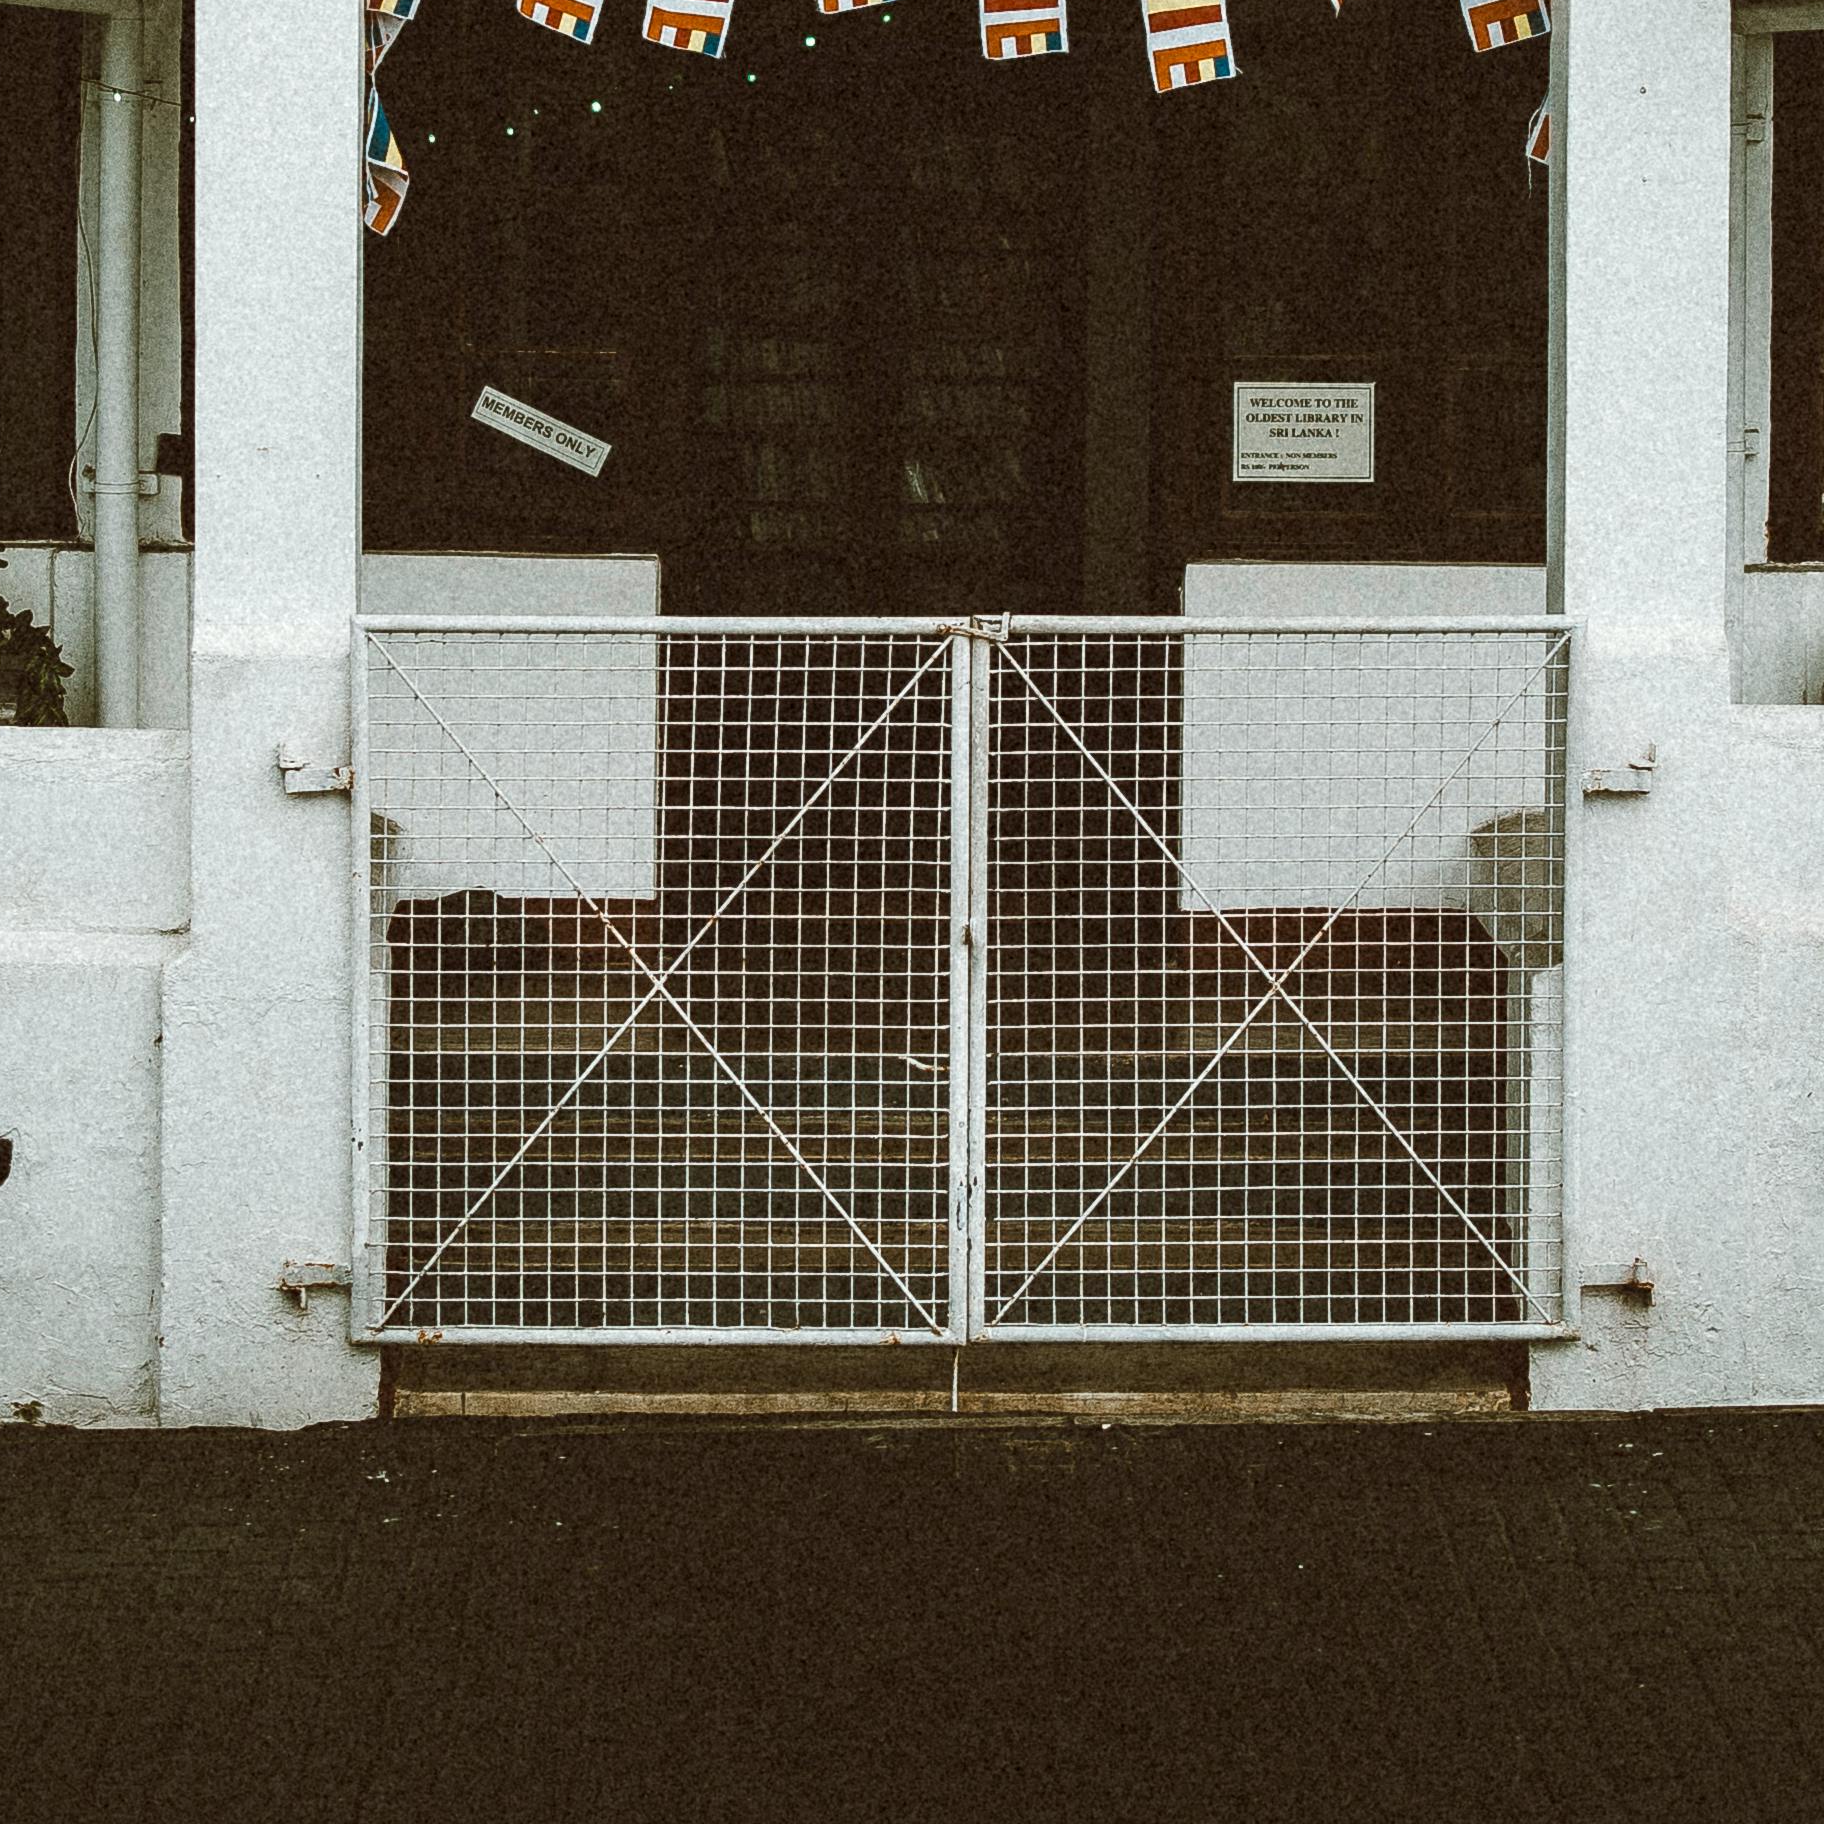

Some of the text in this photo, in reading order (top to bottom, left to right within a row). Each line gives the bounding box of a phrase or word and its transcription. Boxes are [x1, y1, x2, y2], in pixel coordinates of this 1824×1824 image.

[1250, 398, 1358, 408] WELCOME TO THE
[1245, 413, 1364, 423] OLDEST LIBRARY IN
[481, 396, 596, 458] MEMBERS ONLY
[1269, 428, 1288, 438] SRI
[1291, 428, 1333, 438] LANKA
